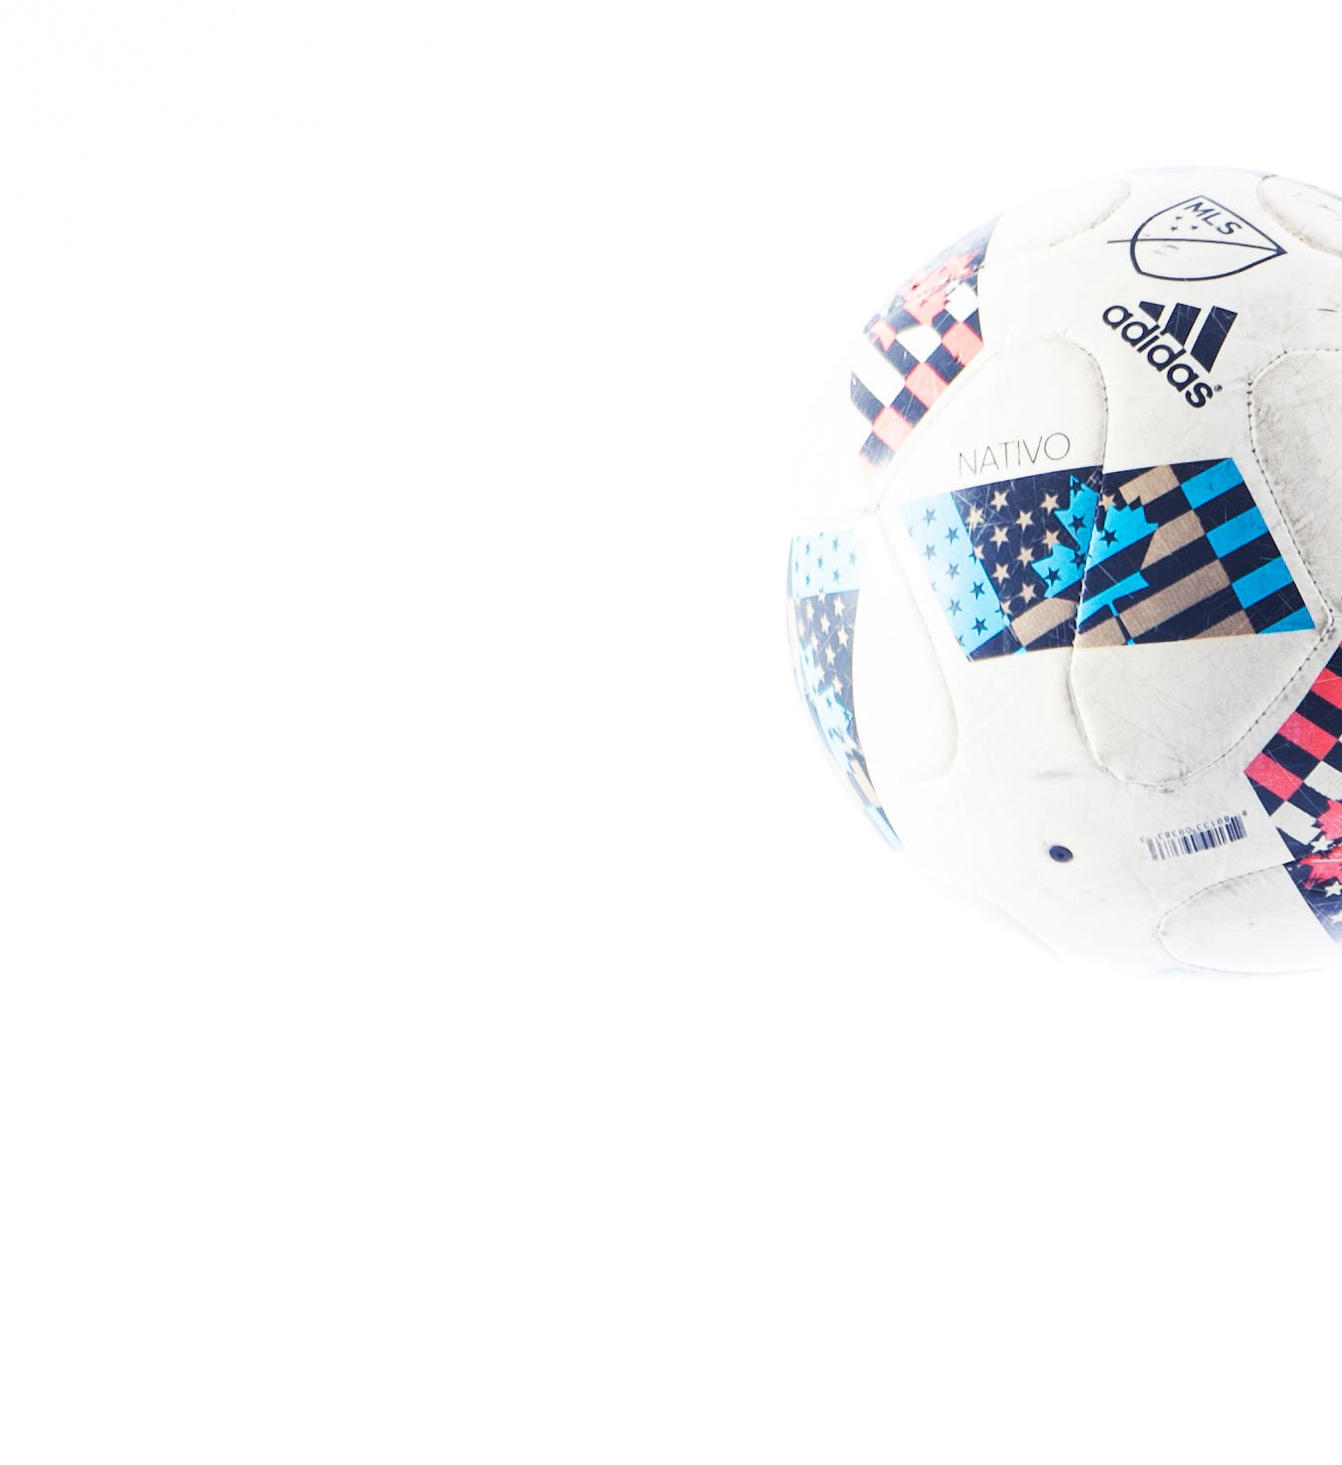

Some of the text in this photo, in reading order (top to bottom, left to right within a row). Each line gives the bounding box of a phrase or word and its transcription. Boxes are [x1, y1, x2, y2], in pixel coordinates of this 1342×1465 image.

[1184, 201, 1242, 235] MLS
[1102, 304, 1213, 409] adidas
[959, 432, 1071, 477] NATIVO
